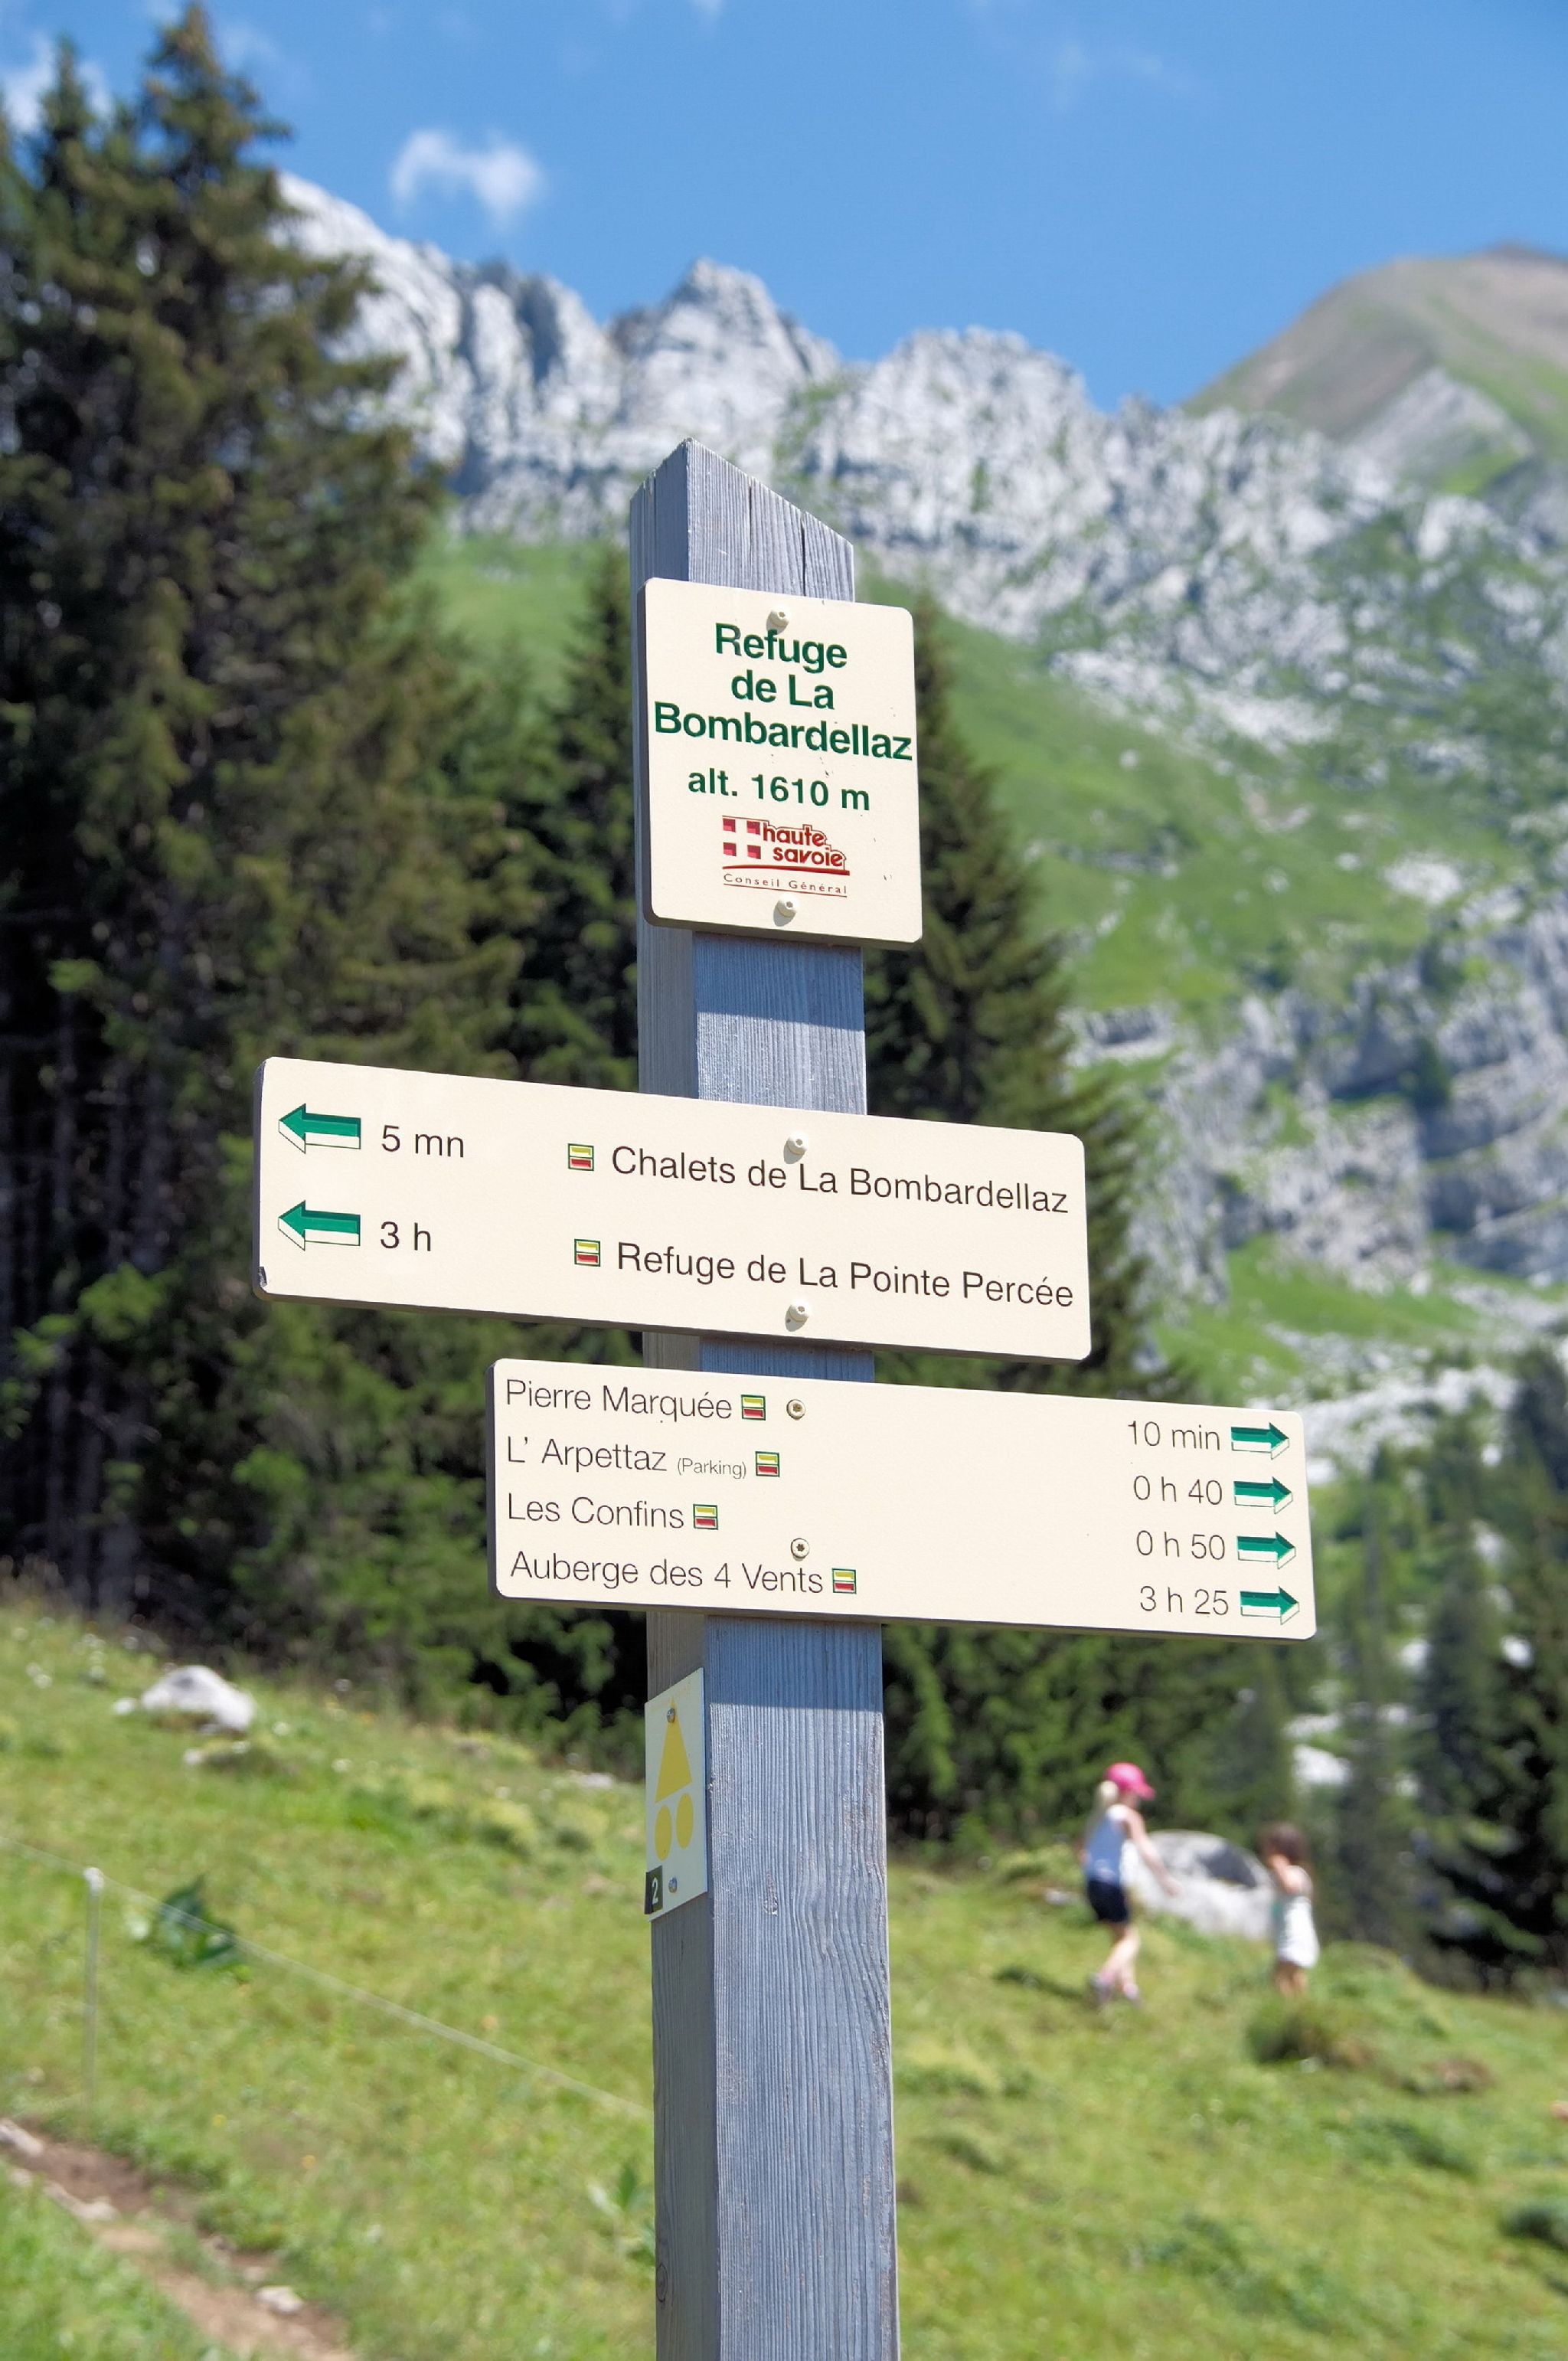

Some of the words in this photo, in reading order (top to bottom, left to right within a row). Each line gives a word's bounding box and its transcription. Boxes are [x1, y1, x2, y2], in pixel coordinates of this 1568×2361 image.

[715, 623, 848, 674] Refuge
[731, 669, 776, 702] de
[789, 674, 835, 710] La
[655, 701, 913, 761] Bombardellaz
[688, 767, 738, 796] alt.
[751, 773, 828, 806] 1610
[841, 788, 870, 811] m
[763, 822, 825, 848] haute
[773, 845, 844, 867] savoie
[724, 874, 780, 888] Conseil
[789, 878, 848, 894] Général
[381, 1124, 400, 1153] 5
[414, 1133, 465, 1158] mn
[612, 1146, 736, 1184] Chalets
[747, 1160, 787, 1189] de
[799, 1163, 838, 1194] La
[851, 1168, 1069, 1214] Bombardellaz
[380, 1221, 399, 1249] 3
[413, 1222, 432, 1252] h
[618, 1241, 735, 1284] Refuge
[747, 1254, 786, 1284] de
[799, 1257, 838, 1288] La
[851, 1261, 950, 1297] Pointe
[963, 1271, 1073, 1308] Percée
[506, 1378, 591, 1411] Pierre
[603, 1385, 732, 1422] Marquée
[1127, 1420, 1160, 1447] 10
[1172, 1424, 1220, 1451] min
[541, 1437, 667, 1472] Arpettaz
[677, 1458, 747, 1479] (Parking)
[1133, 1475, 1151, 1500] 0
[1161, 1476, 1176, 1502] h
[1188, 1479, 1223, 1506] 40
[508, 1493, 560, 1522] Les
[571, 1496, 684, 1529] Confins
[1136, 1530, 1153, 1556] 0
[1165, 1532, 1180, 1558] h
[1191, 1534, 1226, 1560] 50
[510, 1551, 639, 1589] Auberge
[650, 1558, 703, 1587] des
[714, 1561, 732, 1588] 4
[742, 1562, 823, 1593] Vents
[1140, 1585, 1156, 1611] 3
[1168, 1587, 1183, 1613] h
[1194, 1589, 1229, 1615] 25
[652, 1877, 658, 1905] 2
